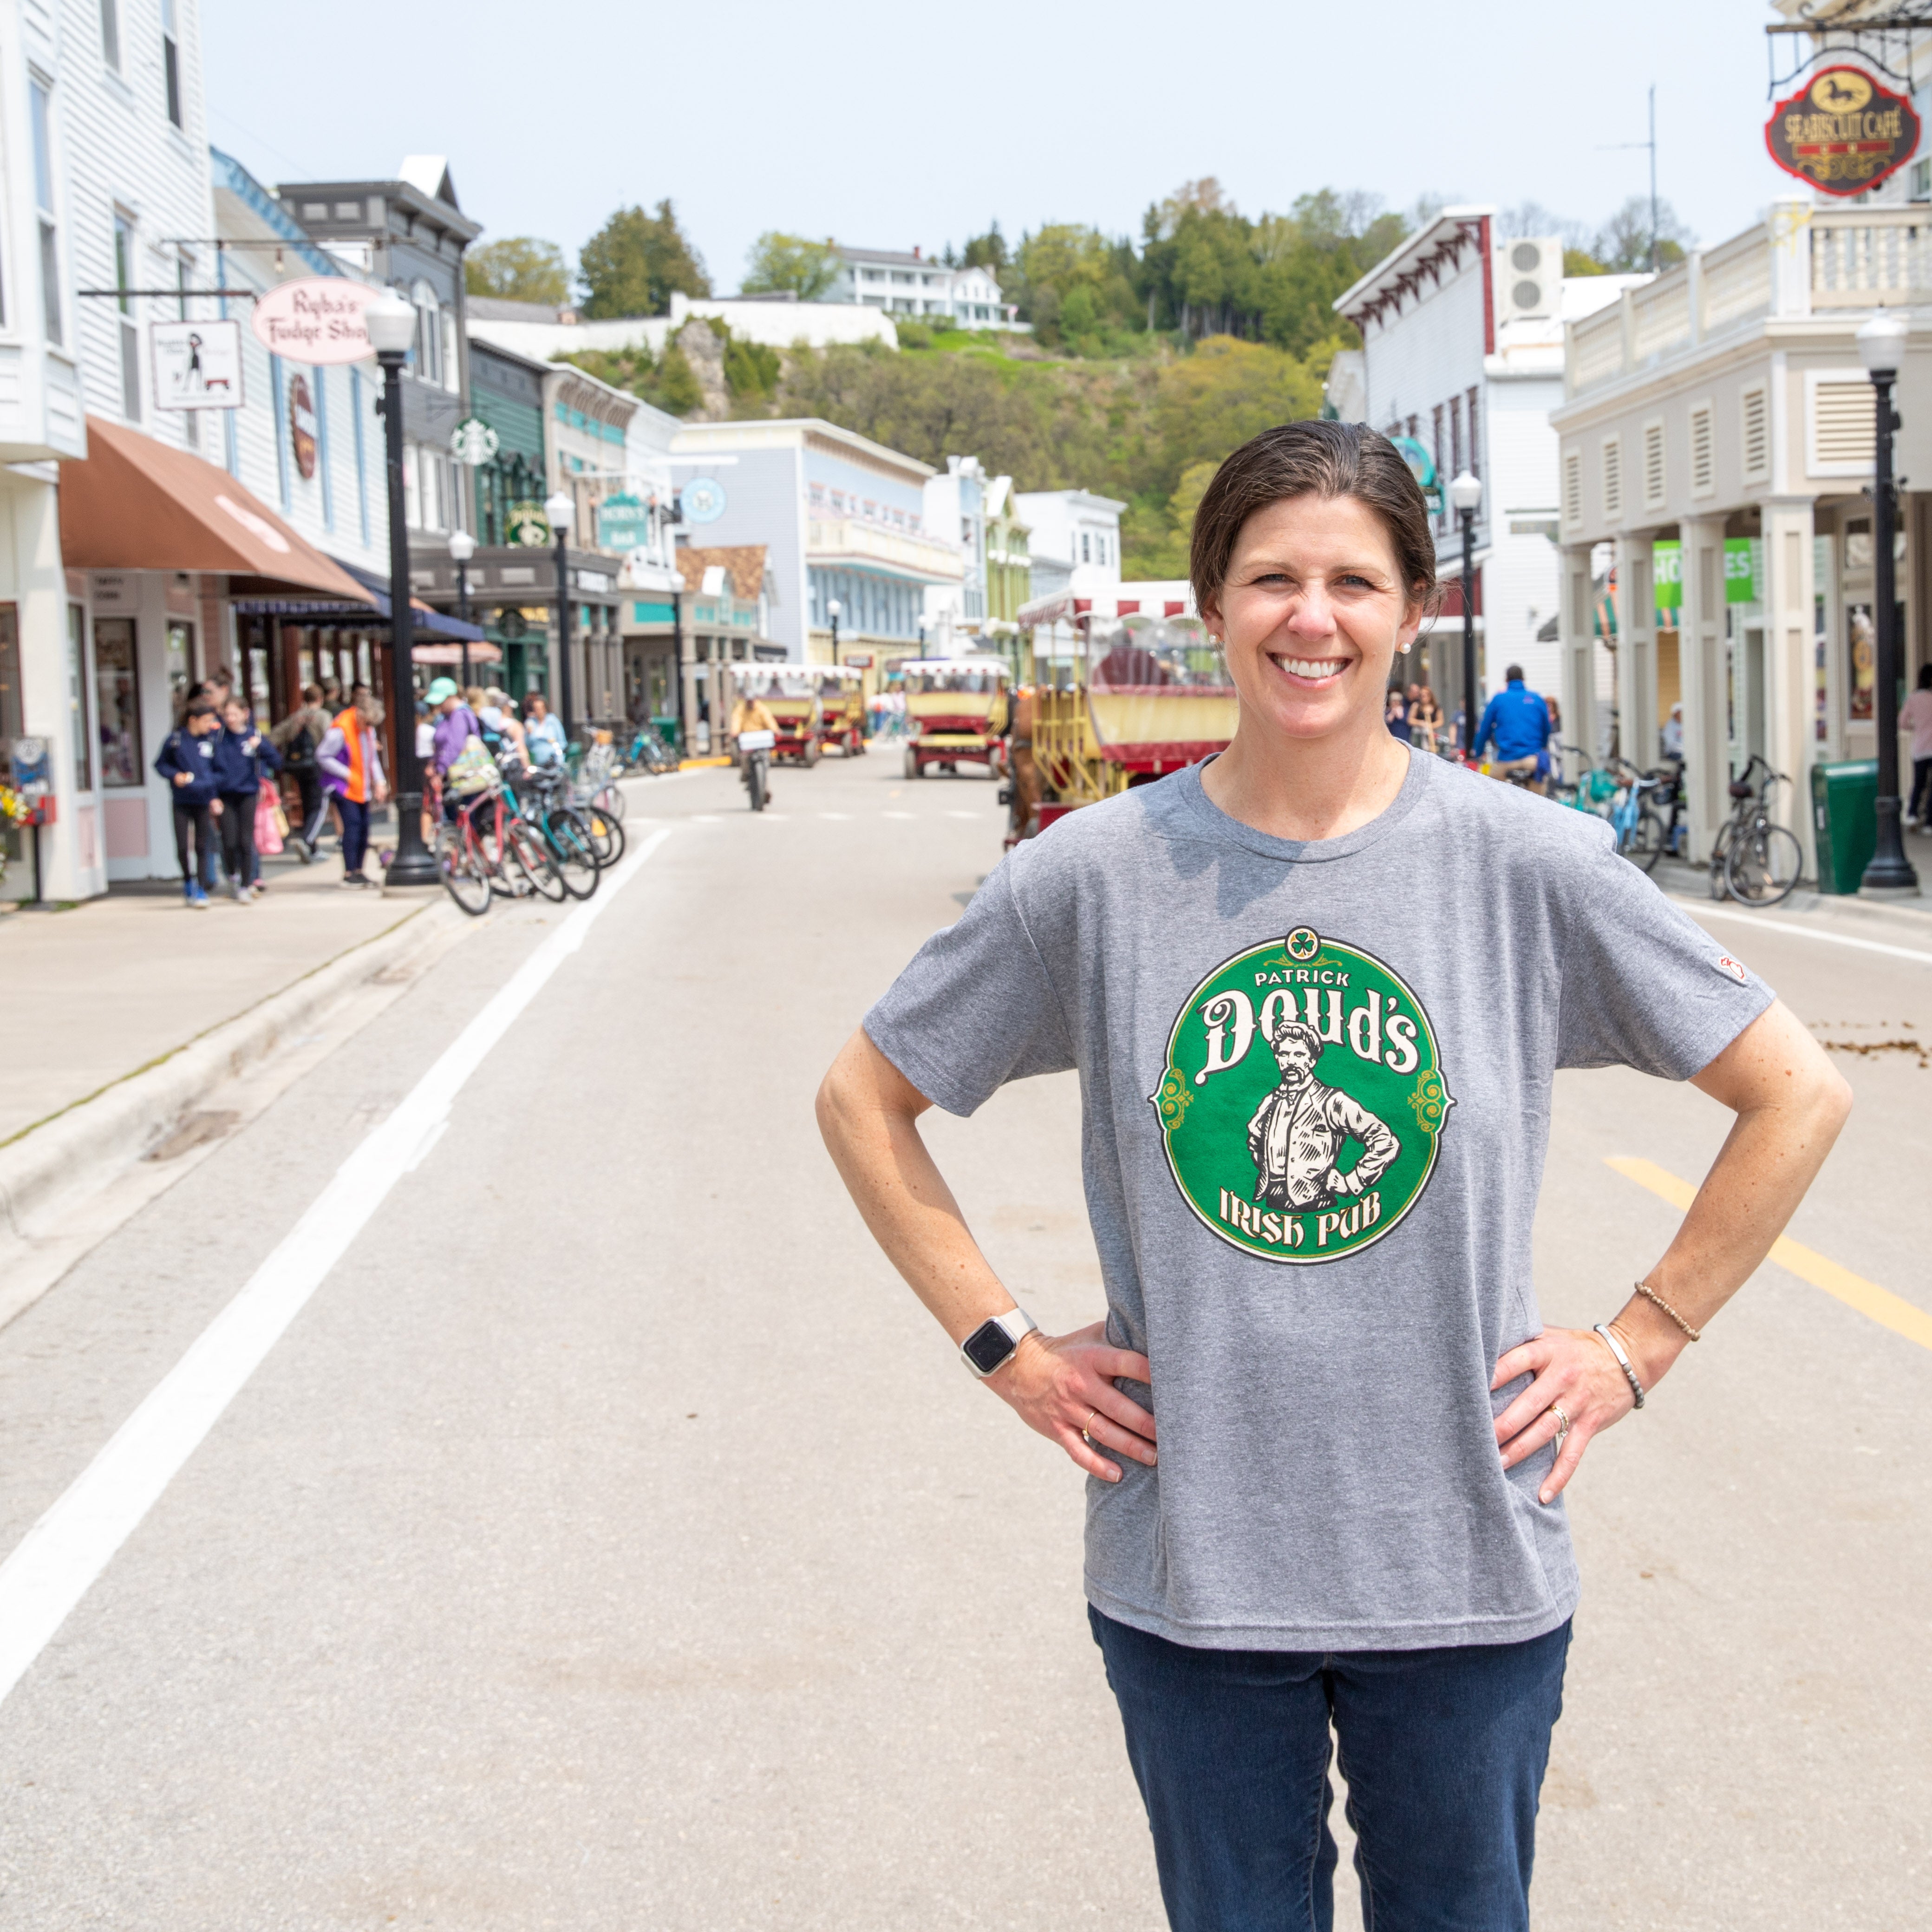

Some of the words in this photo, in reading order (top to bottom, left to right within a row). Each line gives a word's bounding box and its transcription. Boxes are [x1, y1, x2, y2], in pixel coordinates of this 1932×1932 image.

[1784, 112, 1861, 143] SEABISCUIT
[293, 287, 357, 320] Ryba's
[266, 317, 322, 347] Fudge
[328, 319, 368, 340] Sho
[1255, 969, 1351, 988] PATRICK
[1194, 988, 1420, 1086] Doud's
[1315, 1191, 1382, 1247] PUB
